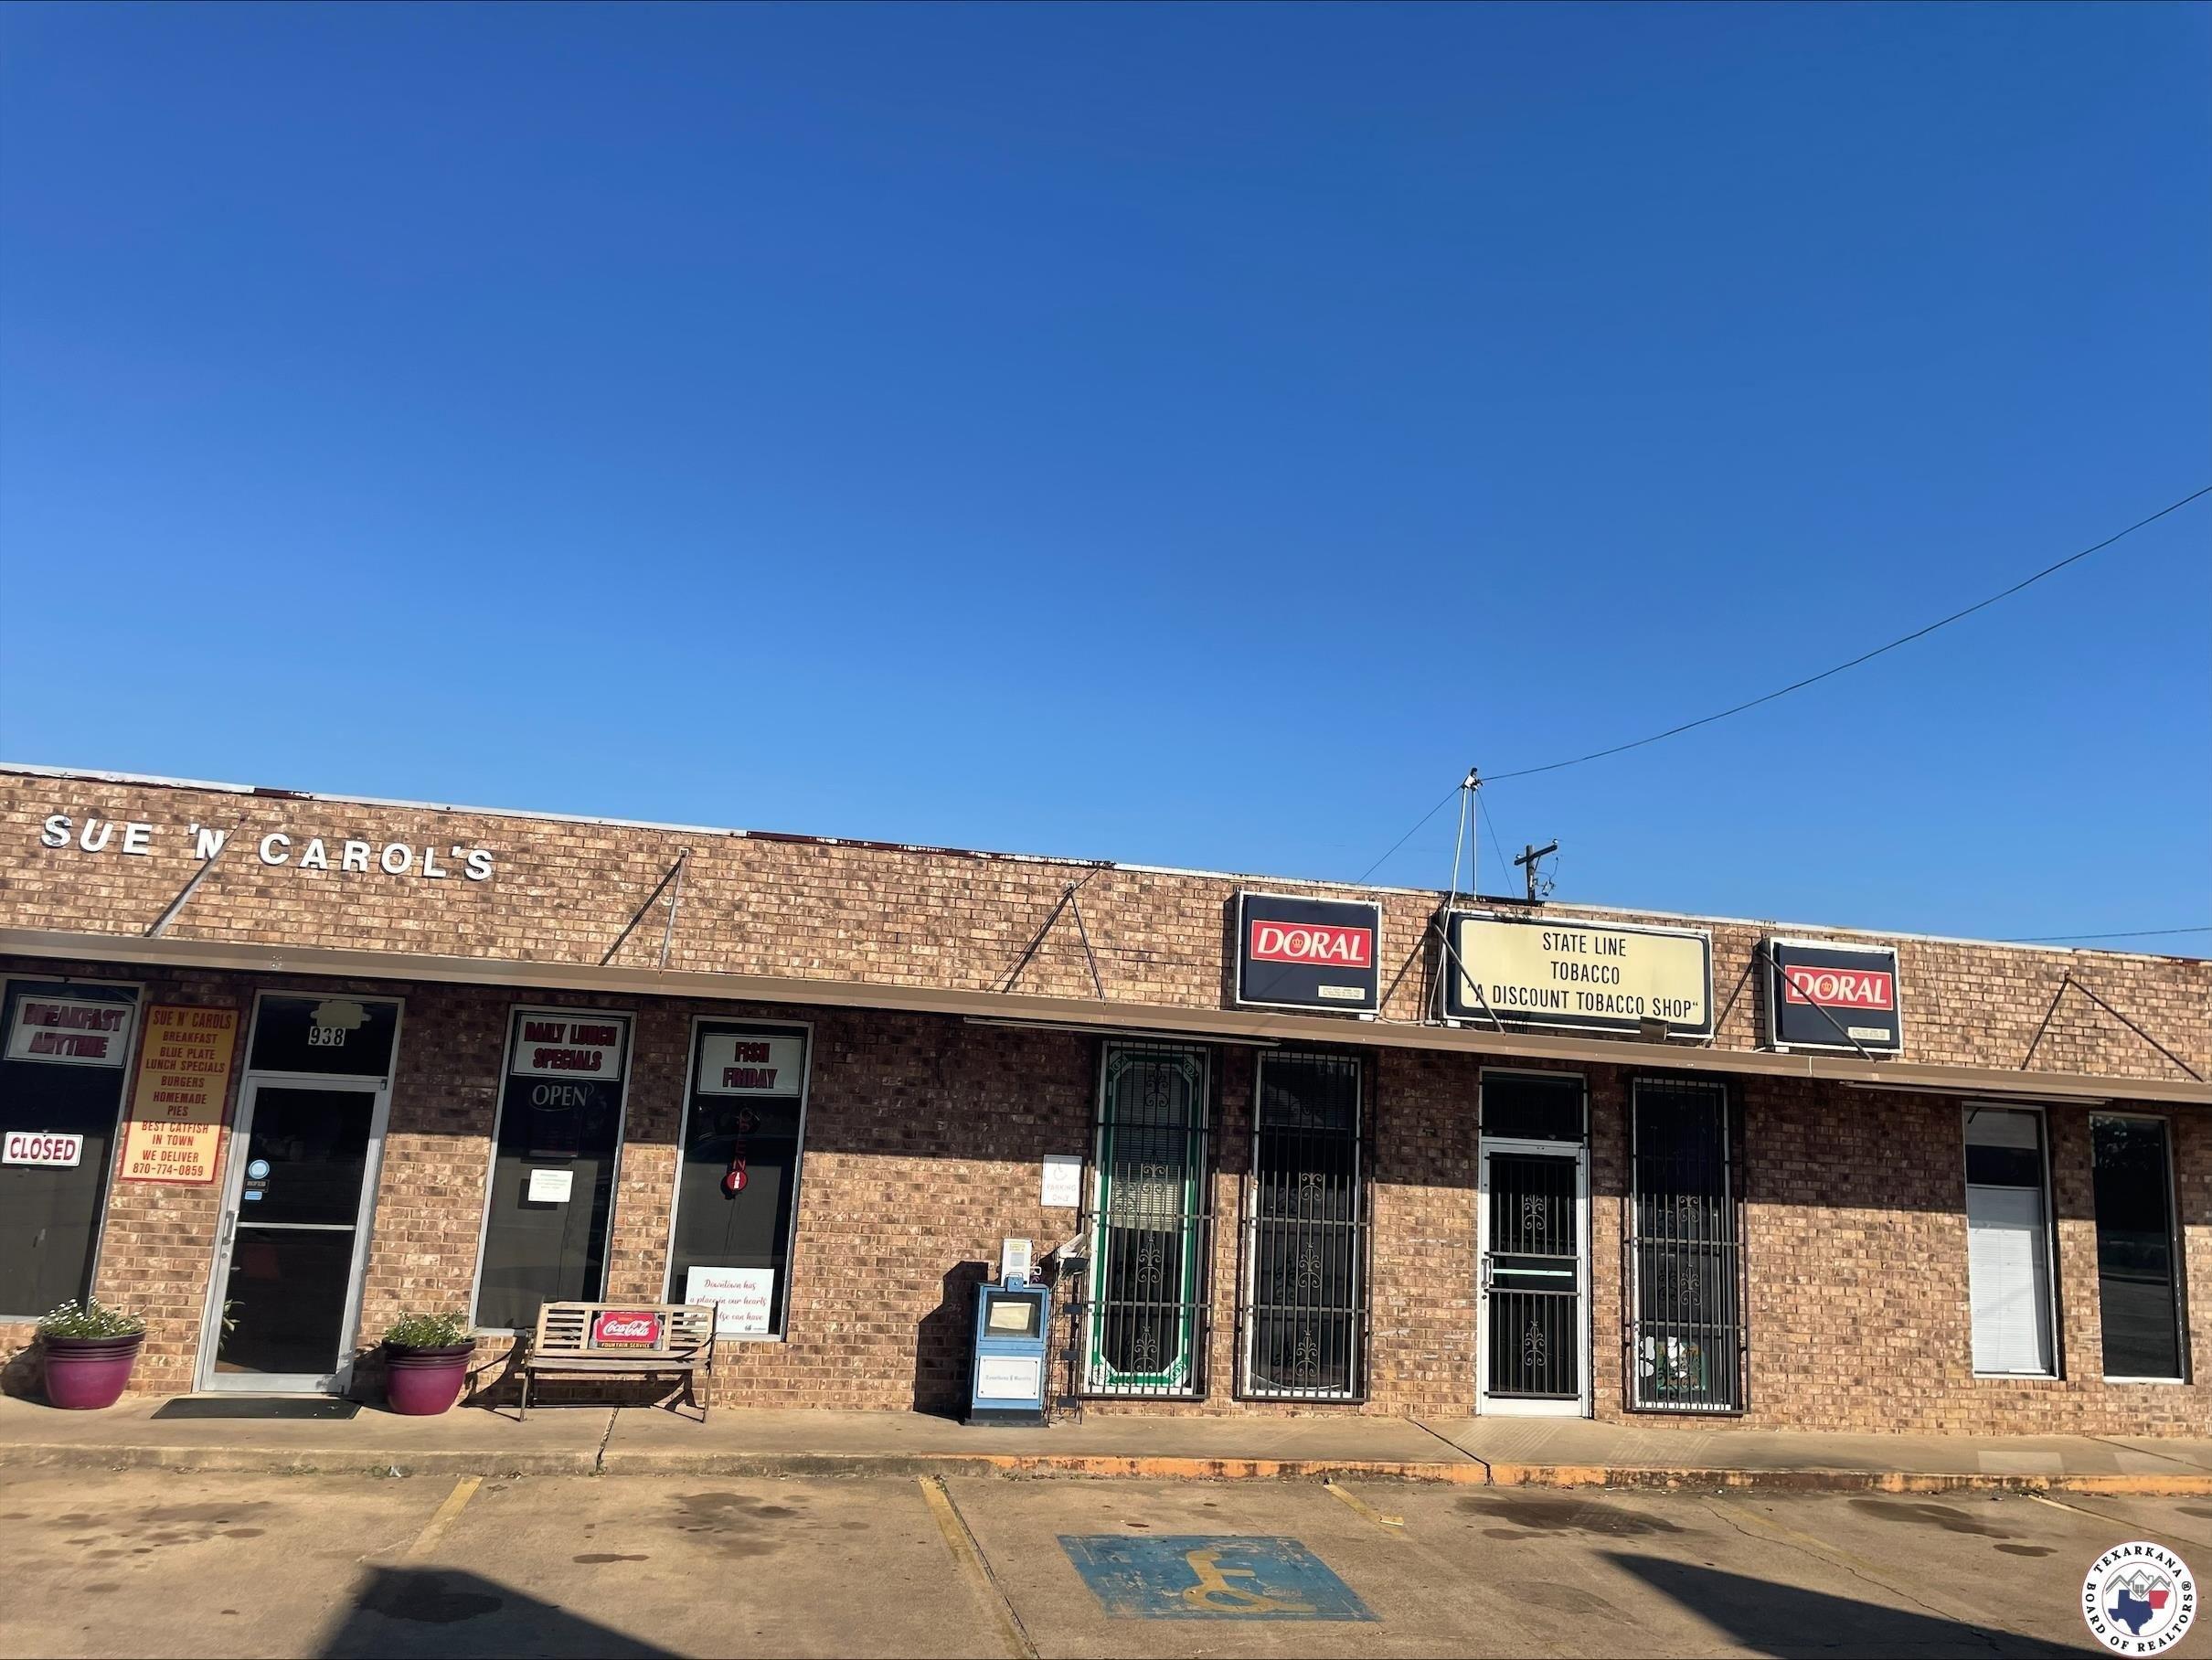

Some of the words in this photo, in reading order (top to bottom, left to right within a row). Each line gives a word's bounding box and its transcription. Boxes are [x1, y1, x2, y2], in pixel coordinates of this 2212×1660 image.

[40, 814, 154, 856] SUE
[259, 832, 495, 880] CAROL'S
[1257, 928, 1365, 961] DORAL
[1542, 932, 1589, 953] STATE
[1595, 936, 1627, 956] LINE
[1550, 961, 1621, 984] TOBACCO
[1791, 972, 1887, 1004] DORAL
[1493, 984, 1569, 1008] DISCOUNT
[1576, 992, 1644, 1015] TOBACCO
[23, 1004, 126, 1031] BREAKFAST
[153, 1010, 174, 1026] SUE
[163, 1030, 218, 1044] BREAKFAST
[310, 1027, 344, 1045] 938
[524, 1022, 567, 1043] DAILY
[569, 1024, 618, 1046] LUNCH
[28, 1031, 110, 1058] ANYTIME
[160, 1047, 183, 1058] BLUE
[186, 1048, 216, 1059] PLATE
[735, 1042, 770, 1062] FISH
[145, 1059, 176, 1069] LUNCH
[181, 1060, 225, 1073] SPECIALS
[532, 1048, 602, 1071] SPECIALS
[161, 1075, 206, 1088] BURGERS
[722, 1067, 778, 1089] FRIDAY
[153, 1091, 207, 1104] HOMEMADE
[532, 1084, 588, 1106] OPEN
[167, 1104, 189, 1116] PIES
[142, 1121, 166, 1132] BEST
[169, 1122, 208, 1133] CATFISH
[9, 1136, 77, 1162] CLOSED
[152, 1134, 163, 1144] IN
[167, 1134, 194, 1146] TOWN
[143, 1150, 157, 1161] WE
[161, 1150, 199, 1163] DELIVER
[133, 1163, 204, 1176] 870-774-0859
[704, 1280, 741, 1288] Downtown
[743, 1280, 757, 1290] has
[743, 1296, 767, 1306] hearts
[746, 1312, 762, 1321] have
